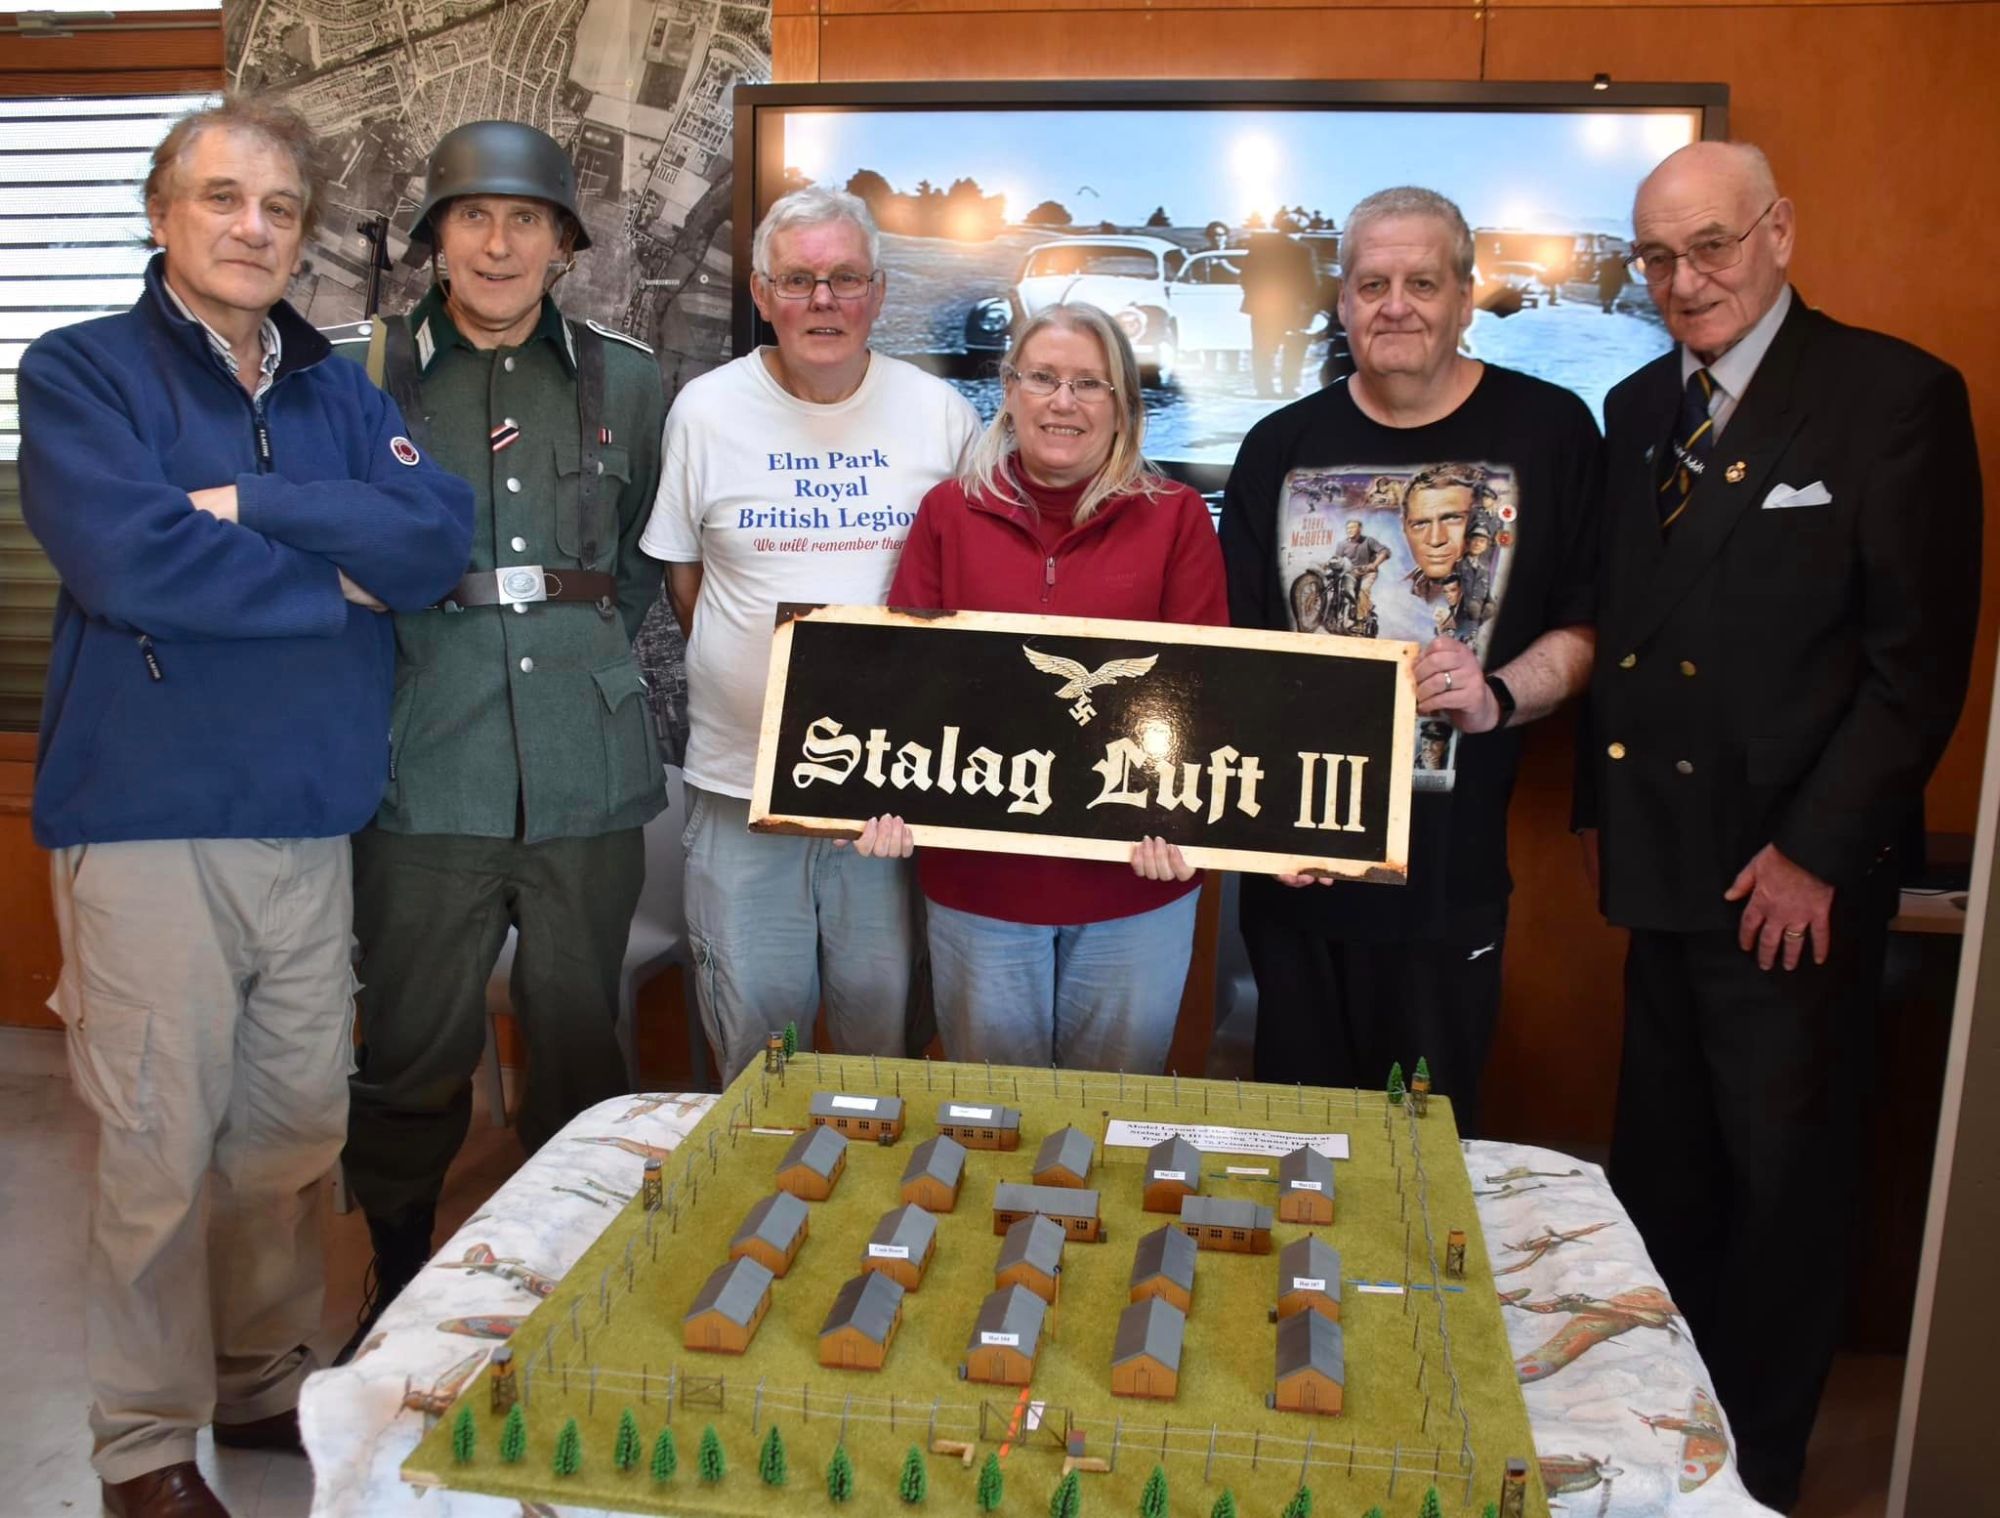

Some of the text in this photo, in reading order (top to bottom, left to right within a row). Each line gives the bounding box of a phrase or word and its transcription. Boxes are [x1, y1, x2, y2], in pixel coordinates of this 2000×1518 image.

[767, 449, 890, 471] Elm Park
[794, 475, 869, 503] Royal
[737, 507, 830, 530] British
[753, 538, 776, 553] We
[780, 537, 808, 553] will
[811, 537, 879, 553] remember
[793, 716, 1371, 833] Stalag Luft III
